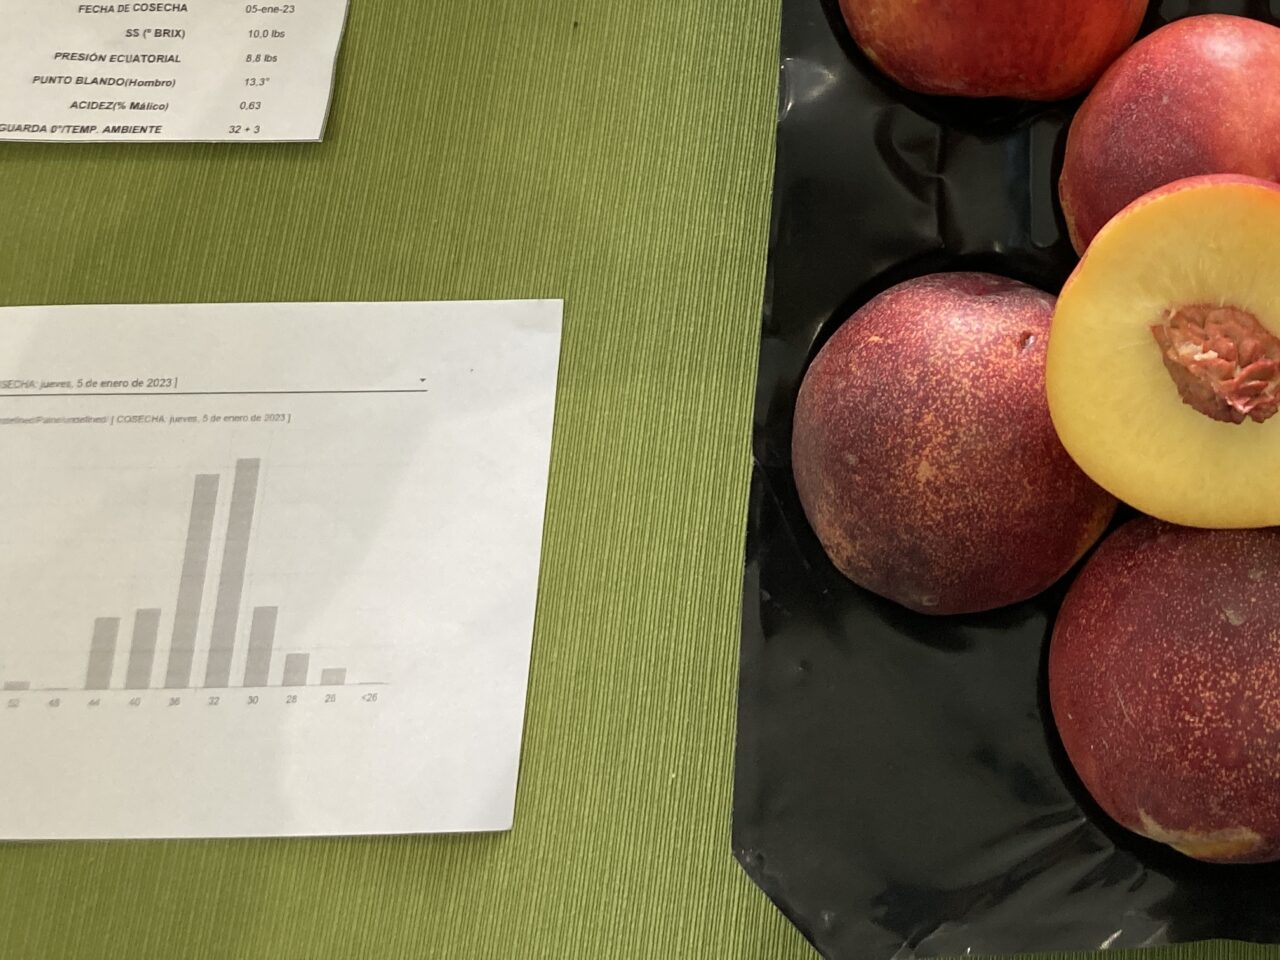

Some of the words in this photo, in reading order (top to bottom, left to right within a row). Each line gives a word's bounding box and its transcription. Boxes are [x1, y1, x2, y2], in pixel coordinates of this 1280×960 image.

[78, 4, 115, 14] FECHA
[117, 4, 131, 13] DE
[132, 3, 188, 12] COSECHA
[245, 4, 295, 13] 05-ene-23
[125, 29, 140, 38] SS
[154, 28, 186, 39] BRIX)
[271, 29, 286, 38] lbs
[54, 51, 106, 63] PRESIÓN
[108, 54, 181, 63] ECUATORIAL
[263, 54, 278, 62] lbs
[32, 75, 73, 85] PUNTO
[129, 101, 169, 112] Málico)
[0, 123, 48, 133] GUARDA
[102, 125, 163, 134] AMBIENTE
[228, 125, 242, 134] 32
[253, 125, 261, 134] 3
[76, 378, 84, 388] 5
[85, 378, 98, 388] de
[100, 379, 129, 388] enero
[131, 378, 144, 388] de
[146, 377, 173, 388] 2023
[210, 413, 222, 422] de
[223, 414, 249, 422] enero
[250, 413, 262, 422] de
[263, 413, 286, 422] 2023
[208, 696, 220, 706] 32
[247, 695, 259, 705] 30
[285, 694, 298, 705] 28
[360, 692, 378, 703] <26
